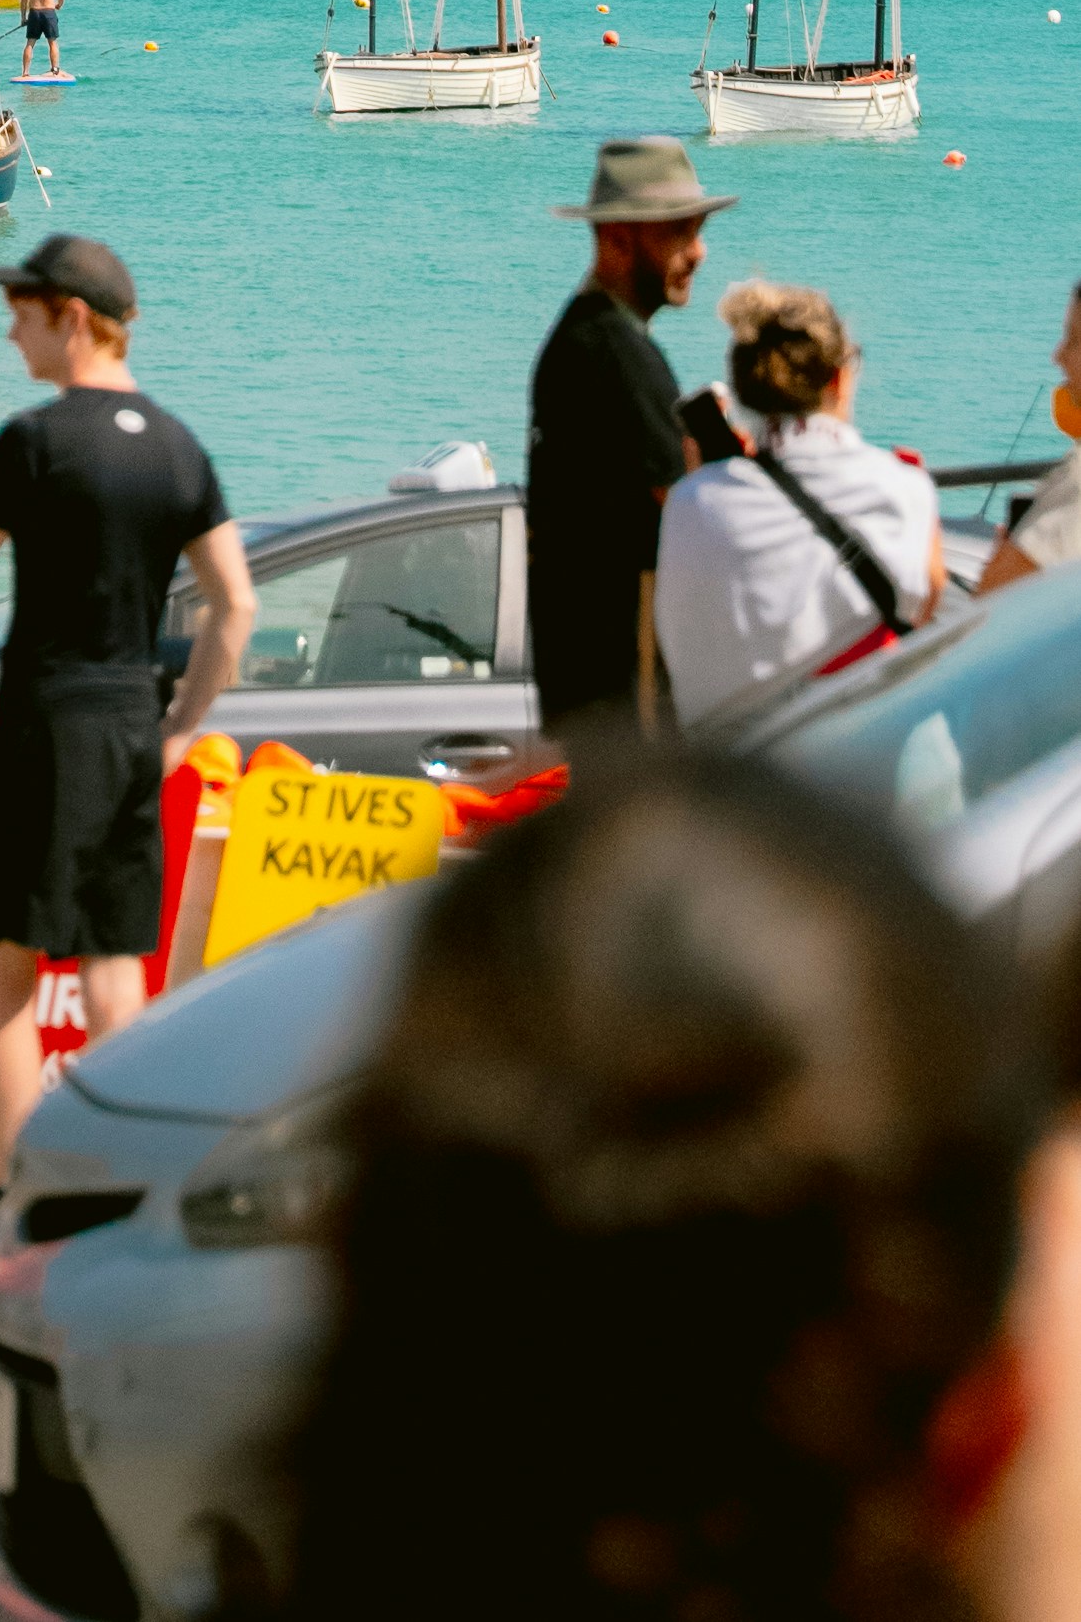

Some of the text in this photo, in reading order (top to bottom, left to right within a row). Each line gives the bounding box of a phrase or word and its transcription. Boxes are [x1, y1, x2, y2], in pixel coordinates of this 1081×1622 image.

[266, 779, 415, 829] ST IVES
[261, 837, 399, 884] KAYAK
